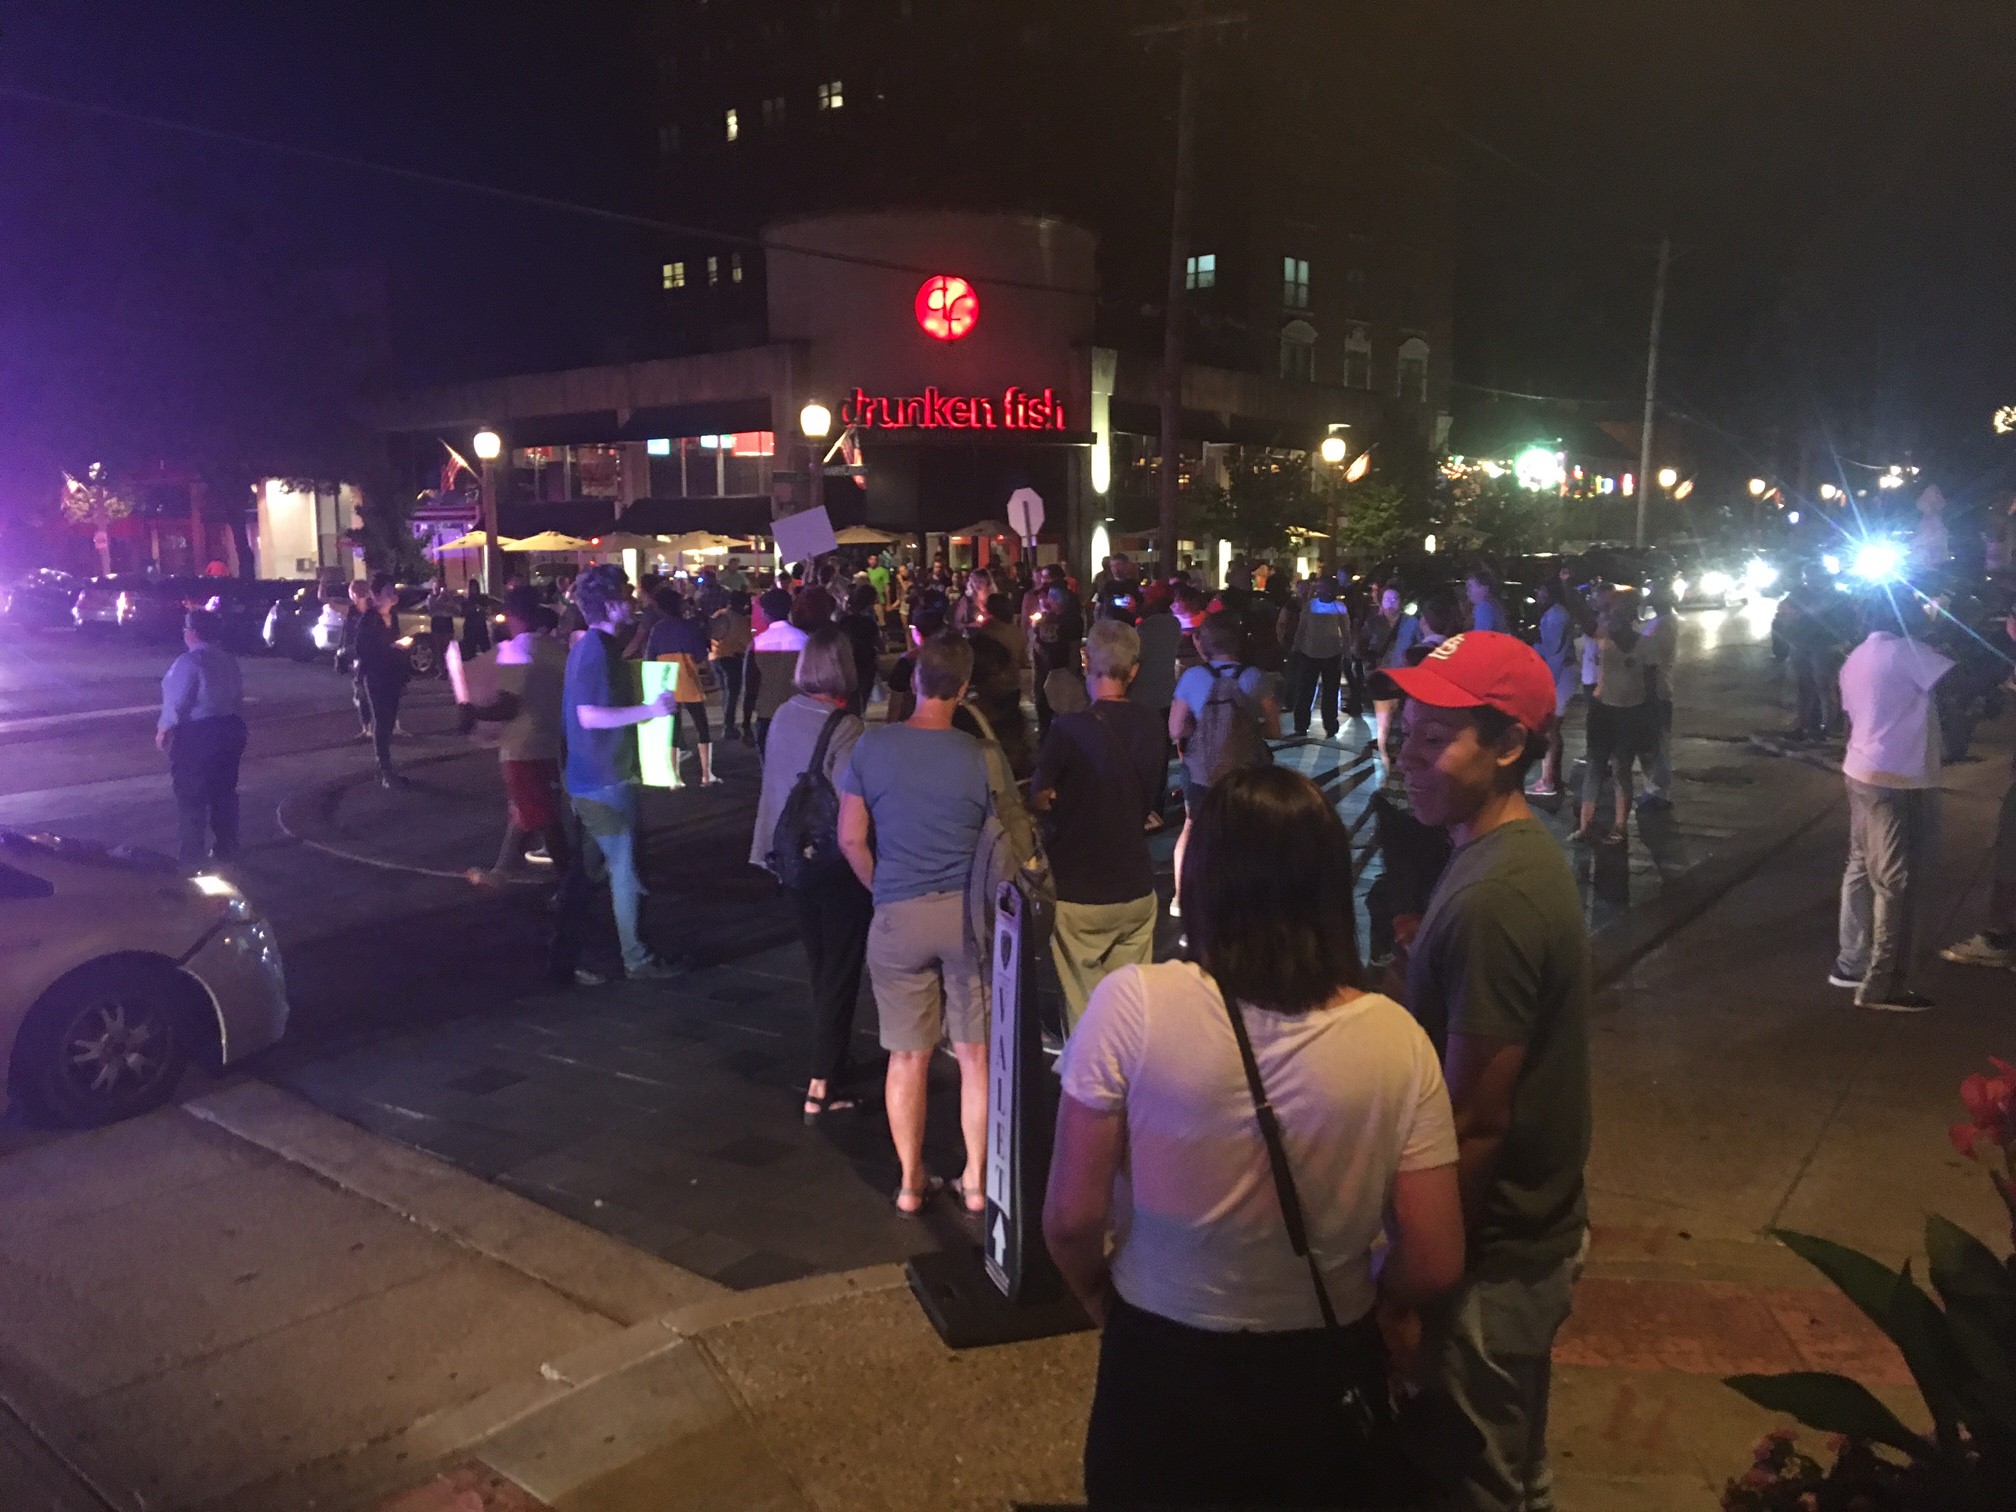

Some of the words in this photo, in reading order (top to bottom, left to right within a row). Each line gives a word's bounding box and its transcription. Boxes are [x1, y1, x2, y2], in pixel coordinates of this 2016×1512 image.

[842, 386, 997, 429] drunken
[1003, 386, 1066, 430] fish
[994, 985, 1008, 1201] VALET
